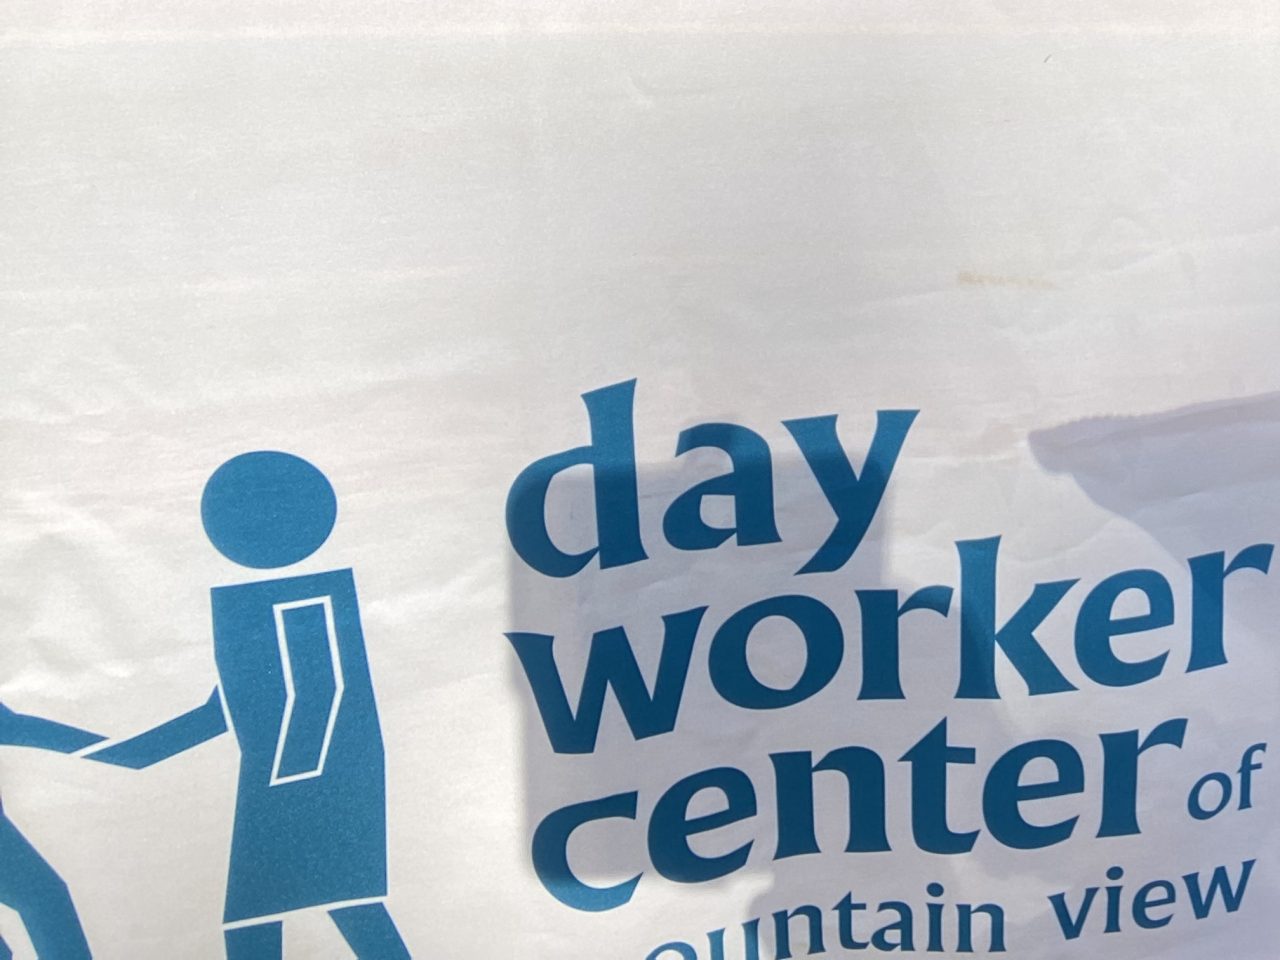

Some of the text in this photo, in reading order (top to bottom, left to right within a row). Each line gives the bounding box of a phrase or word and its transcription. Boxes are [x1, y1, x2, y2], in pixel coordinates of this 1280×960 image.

[504, 377, 920, 580] day
[503, 533, 1275, 756] worker
[530, 716, 1268, 914] center of
[1047, 858, 1257, 942] view
